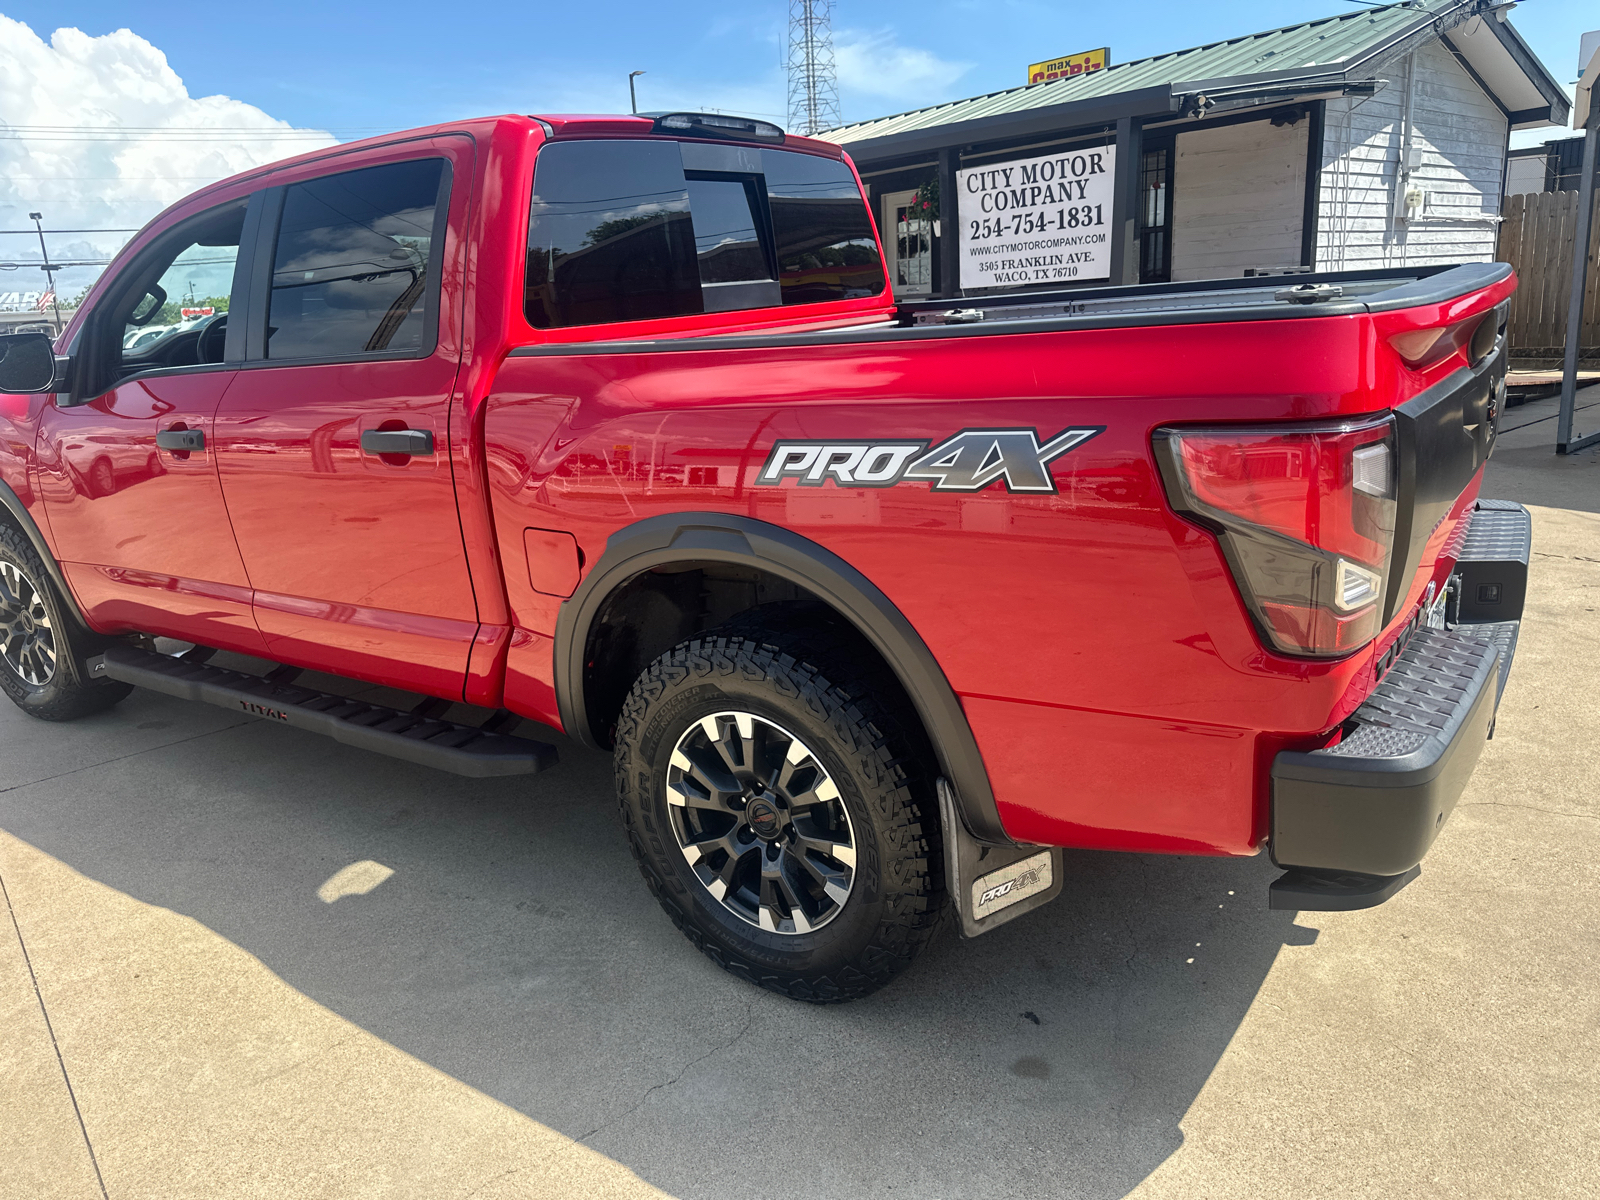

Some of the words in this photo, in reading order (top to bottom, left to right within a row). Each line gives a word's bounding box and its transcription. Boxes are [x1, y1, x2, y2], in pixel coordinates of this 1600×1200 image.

[1047, 59, 1072, 72] max
[966, 167, 1014, 193] CITY
[1020, 152, 1106, 186] MOTOR
[981, 178, 1090, 213] COMPANY
[970, 203, 1105, 241] 254-754-1831
[970, 233, 1106, 257] WWW.CITYMOTORCOMPANY.COM
[979, 260, 999, 272] 3505
[1001, 253, 1064, 270] FRANKLIN
[1066, 251, 1095, 264] AVE.
[994, 270, 1031, 284] WACO,
[1033, 268, 1050, 280] TX
[1052, 266, 1078, 278] 76710
[240, 700, 288, 721] TITAN
